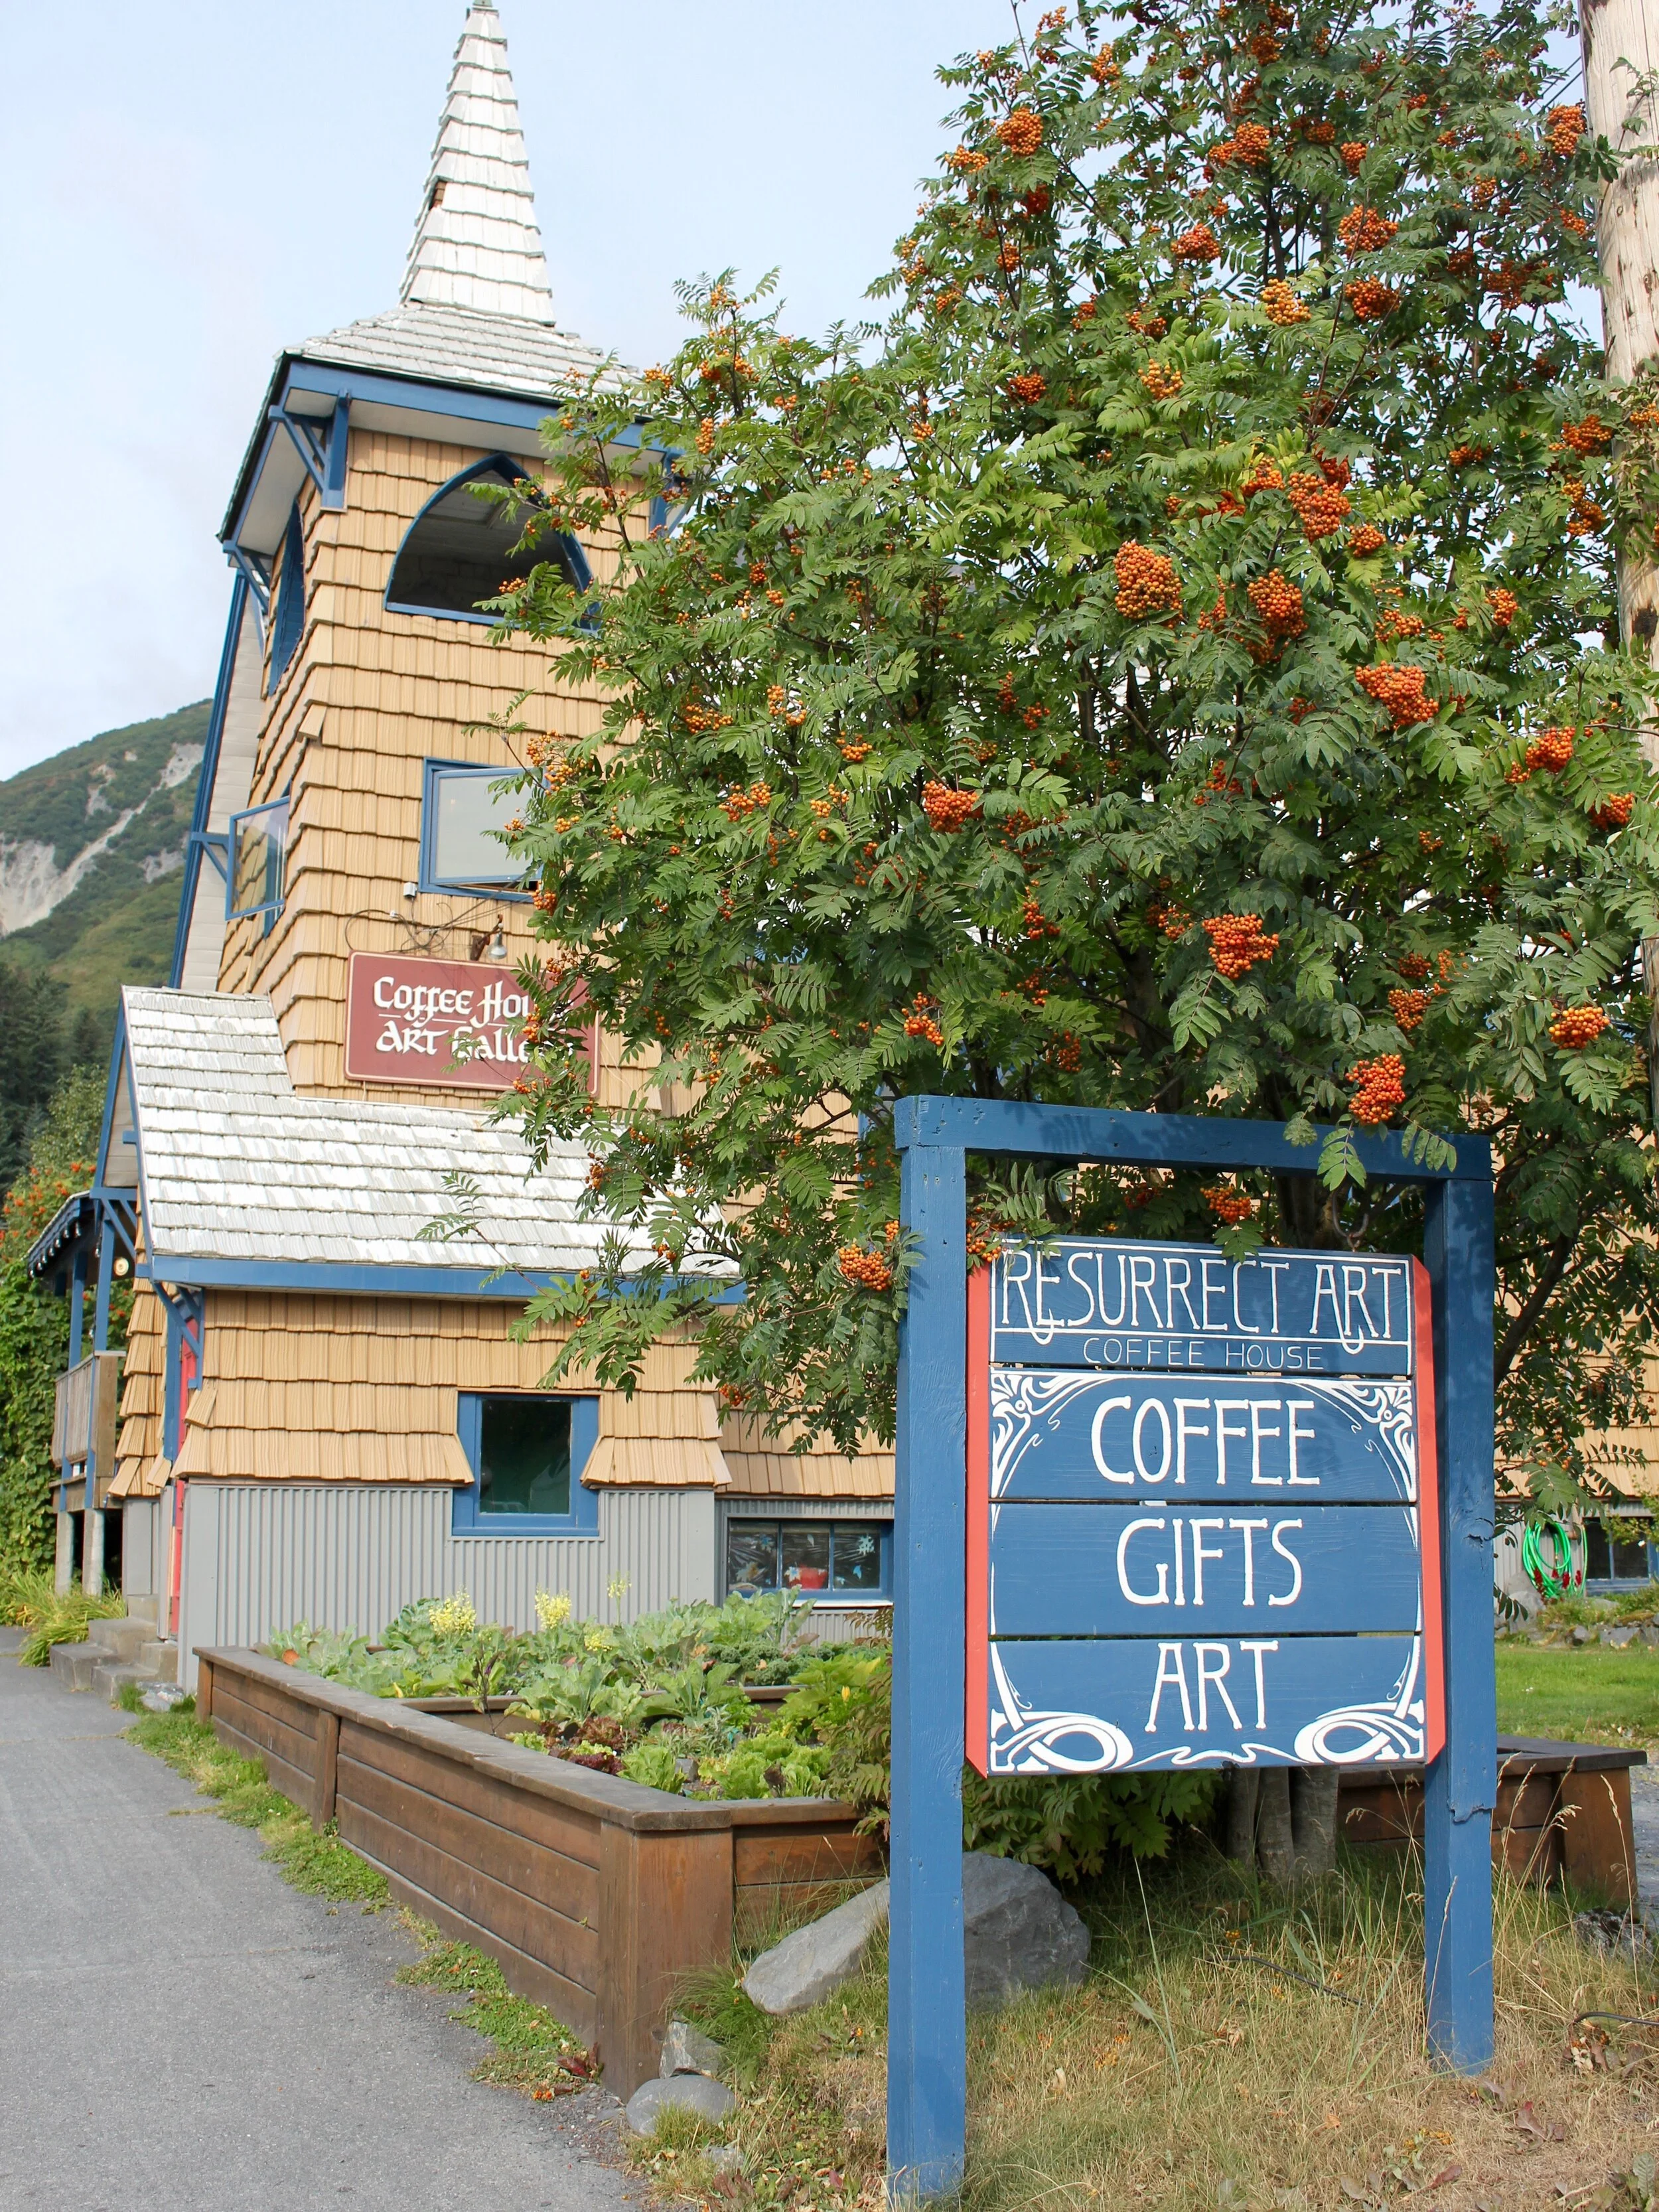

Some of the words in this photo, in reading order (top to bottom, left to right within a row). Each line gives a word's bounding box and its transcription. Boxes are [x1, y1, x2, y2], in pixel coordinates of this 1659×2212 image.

[374, 976, 474, 1028] Coffee
[376, 1020, 449, 1055] ART
[451, 1026, 573, 1069] Galle
[1001, 1250, 1289, 1345] RESURRECT
[1309, 1264, 1402, 1354] ART
[1083, 1337, 1205, 1366] COFFEE
[1225, 1341, 1324, 1370] HOUSE
[1091, 1395, 1321, 1485] COFFEE
[1117, 1518, 1303, 1605] GIFTS
[1145, 1641, 1279, 1732] ART
